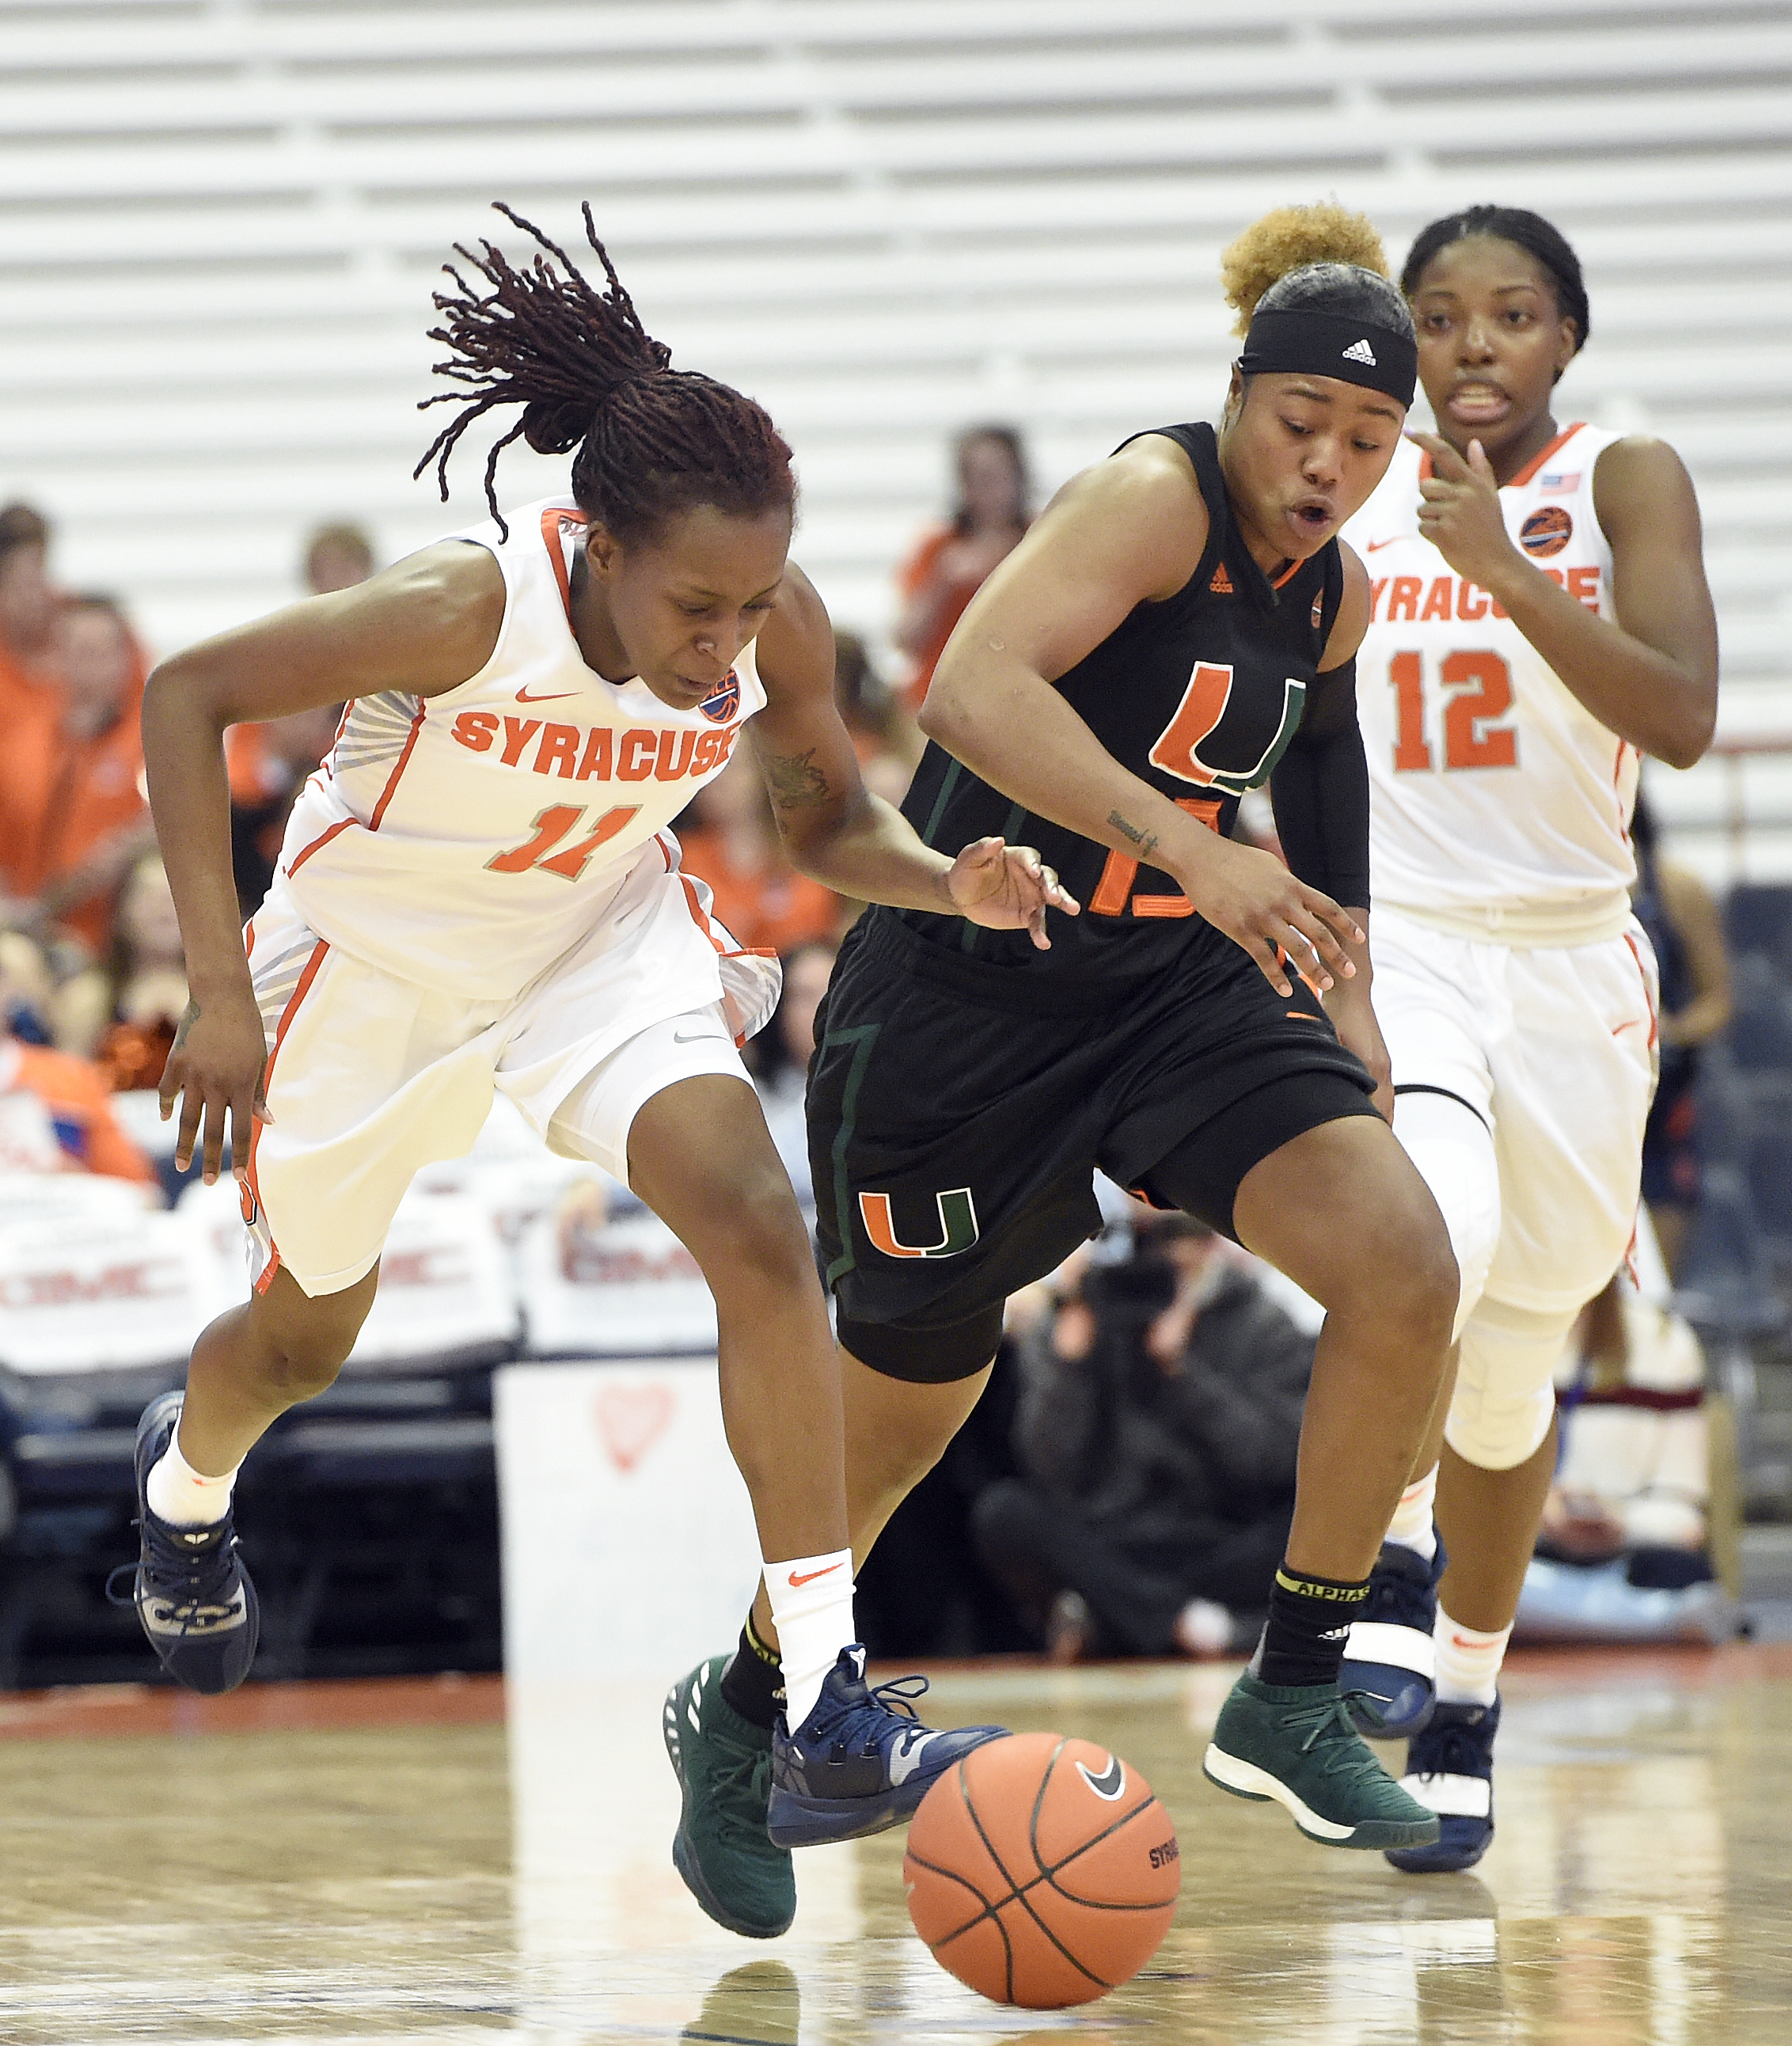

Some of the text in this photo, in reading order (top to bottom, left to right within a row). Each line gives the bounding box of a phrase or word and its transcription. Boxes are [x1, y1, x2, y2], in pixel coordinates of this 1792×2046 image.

[450, 712, 742, 782] SYRACUSE
[1148, 661, 1306, 796] U
[1387, 649, 1520, 773] 12
[483, 803, 644, 883] 11
[859, 1187, 979, 1258] U
